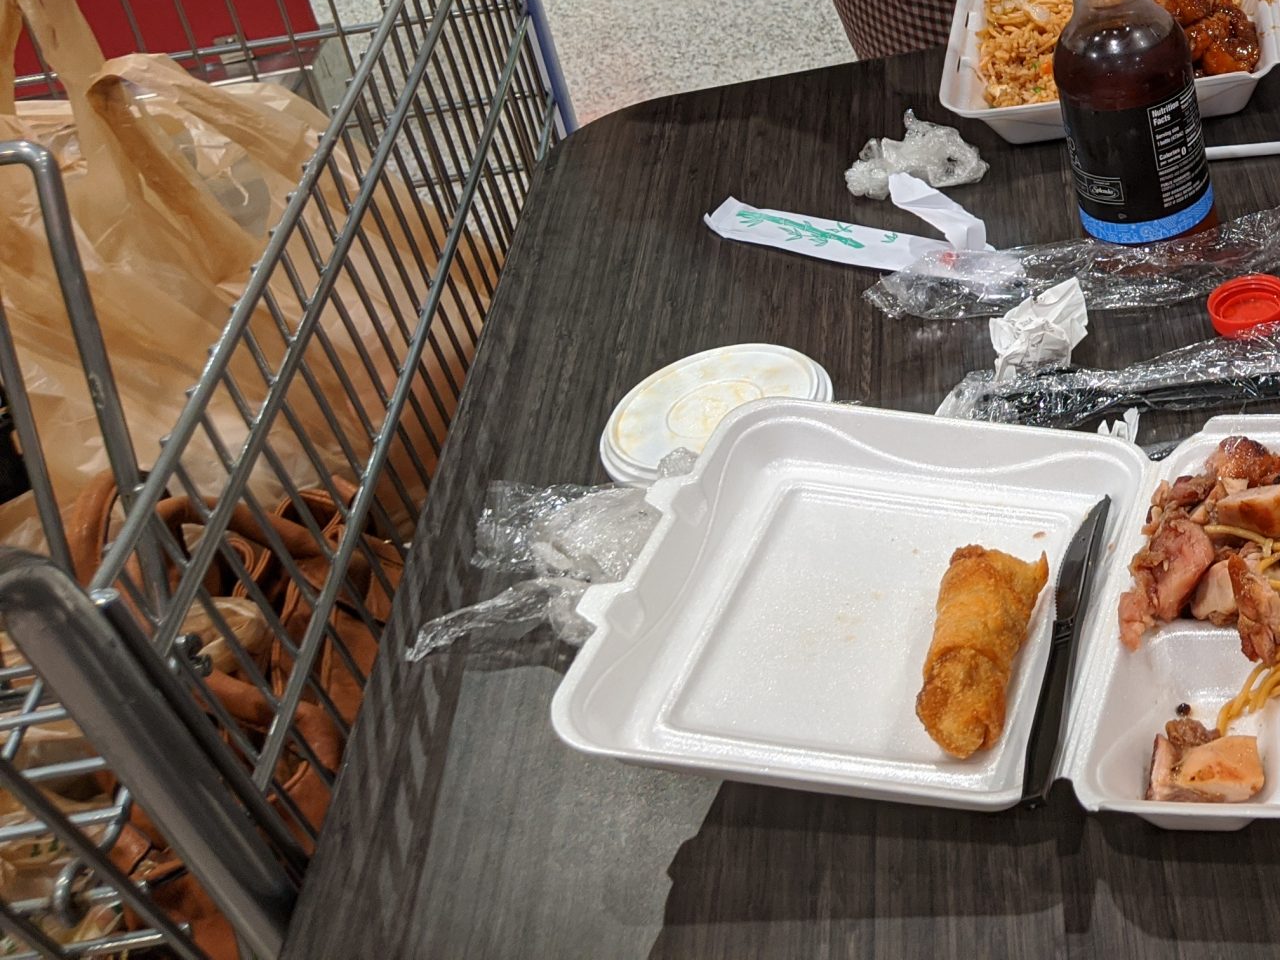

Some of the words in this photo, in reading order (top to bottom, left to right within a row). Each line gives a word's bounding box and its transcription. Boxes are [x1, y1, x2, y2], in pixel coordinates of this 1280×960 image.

[1151, 100, 1180, 118] Nutrition
[1152, 114, 1171, 127] Facts
[1159, 148, 1180, 160] Calories
